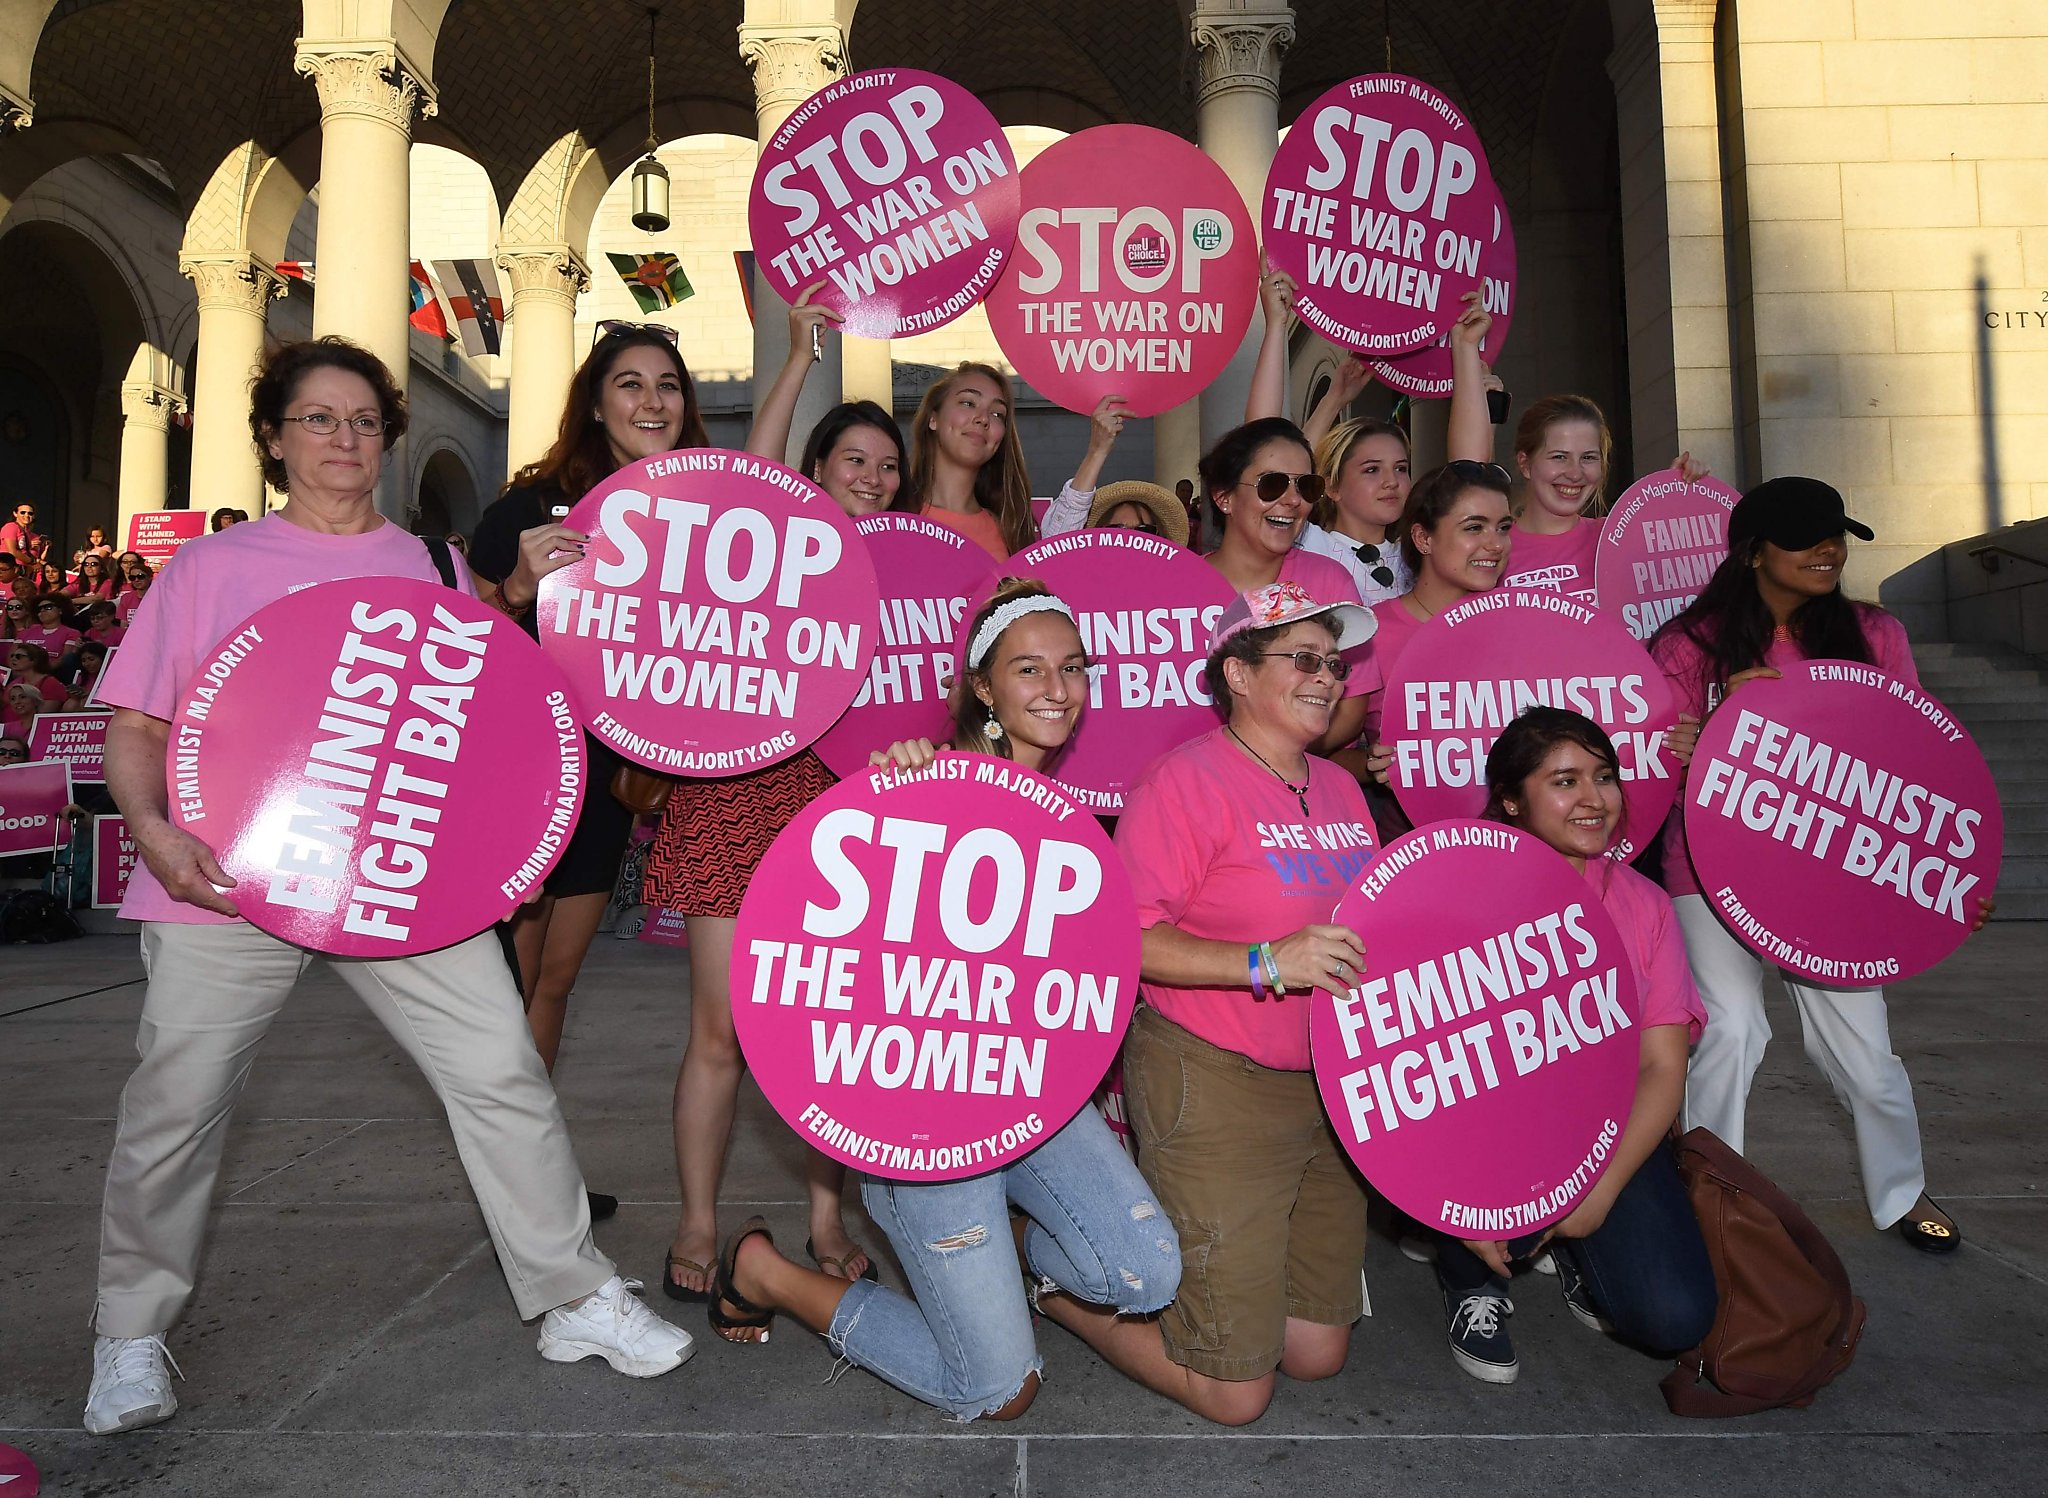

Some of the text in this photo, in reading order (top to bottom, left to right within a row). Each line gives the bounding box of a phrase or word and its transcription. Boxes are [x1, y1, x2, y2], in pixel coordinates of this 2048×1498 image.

[773, 73, 896, 150] FEMINIST MAJORITY
[1349, 78, 1463, 131] FEMINIST MAJORITY
[763, 85, 944, 237] STOP
[1305, 105, 1477, 221] STOP
[770, 139, 1009, 288] THE WAR ON
[1196, 236, 1220, 249] YES
[1197, 220, 1218, 235] ERA
[1272, 188, 1482, 277] THE WAR ON
[828, 201, 990, 303] WOMEN
[1018, 206, 1234, 294] STOP
[1306, 243, 1442, 313] WOMEN
[872, 247, 1003, 333] NISTMAJORITY.ORG
[1018, 301, 1223, 334] THE WAR ON
[1297, 295, 1436, 349] FEMINISTMAJORITY.ORG
[1984, 311, 2048, 329] CITY
[1050, 338, 1192, 373] WOMEN
[645, 454, 817, 504] FEMINIST MAJORITY
[1608, 478, 1737, 546] Feminist Majority Founda
[137, 530, 175, 538] PLANNED
[144, 515, 171, 523] STAND
[593, 488, 842, 609] STOP
[855, 516, 966, 550] INIST MAJORITY
[1024, 533, 1179, 566] FEMINIST MAJORITY
[1641, 513, 1723, 553] FAMILY
[1443, 592, 1510, 628] FEMINIST
[1515, 591, 1595, 625] MAJORITY
[1516, 567, 1575, 584] STAND
[552, 587, 861, 670] THE WAR ON
[1078, 605, 1224, 656] INISTS
[601, 648, 800, 719] WOMEN
[1118, 659, 1214, 708] BAC
[1809, 665, 1964, 743] FEMINIST MAJORITY
[46, 744, 105, 753] PLANNE
[51, 733, 88, 742] WITH
[60, 721, 106, 731] STAND
[176, 624, 265, 823] FEMINIST MAJORITY
[265, 601, 418, 914] FEMINISTS
[592, 711, 797, 771] FEMINISTMAJORITY.ORG
[1611, 731, 1670, 781] CK
[342, 603, 494, 942] FIGHT BACK
[500, 690, 580, 901] FEMINISTMAJORITY.ORG
[869, 759, 970, 795] FEMINIST
[975, 763, 1076, 822] MAJORITY
[1727, 708, 1983, 860] FEMINISTS
[1256, 821, 1373, 850] SHE WINS
[1265, 851, 1331, 885] WE
[1360, 826, 1519, 902] FEMINIST MAJORITY
[1696, 757, 1980, 925] FIGHT BACK
[802, 808, 1102, 958] STOP
[1715, 886, 1900, 980] FEMINISTMAJORITY.ORG
[749, 939, 1120, 1033] THE WAR ON
[1331, 903, 1599, 1060] FEMINISTS
[810, 1020, 1048, 1098] WOMEN
[1339, 966, 1633, 1144] FIGHT BACK
[798, 1103, 1044, 1171] FEMINISTMAJORITY.ORG
[1440, 1117, 1619, 1231] FEMINISTMAJORITY.ORG
